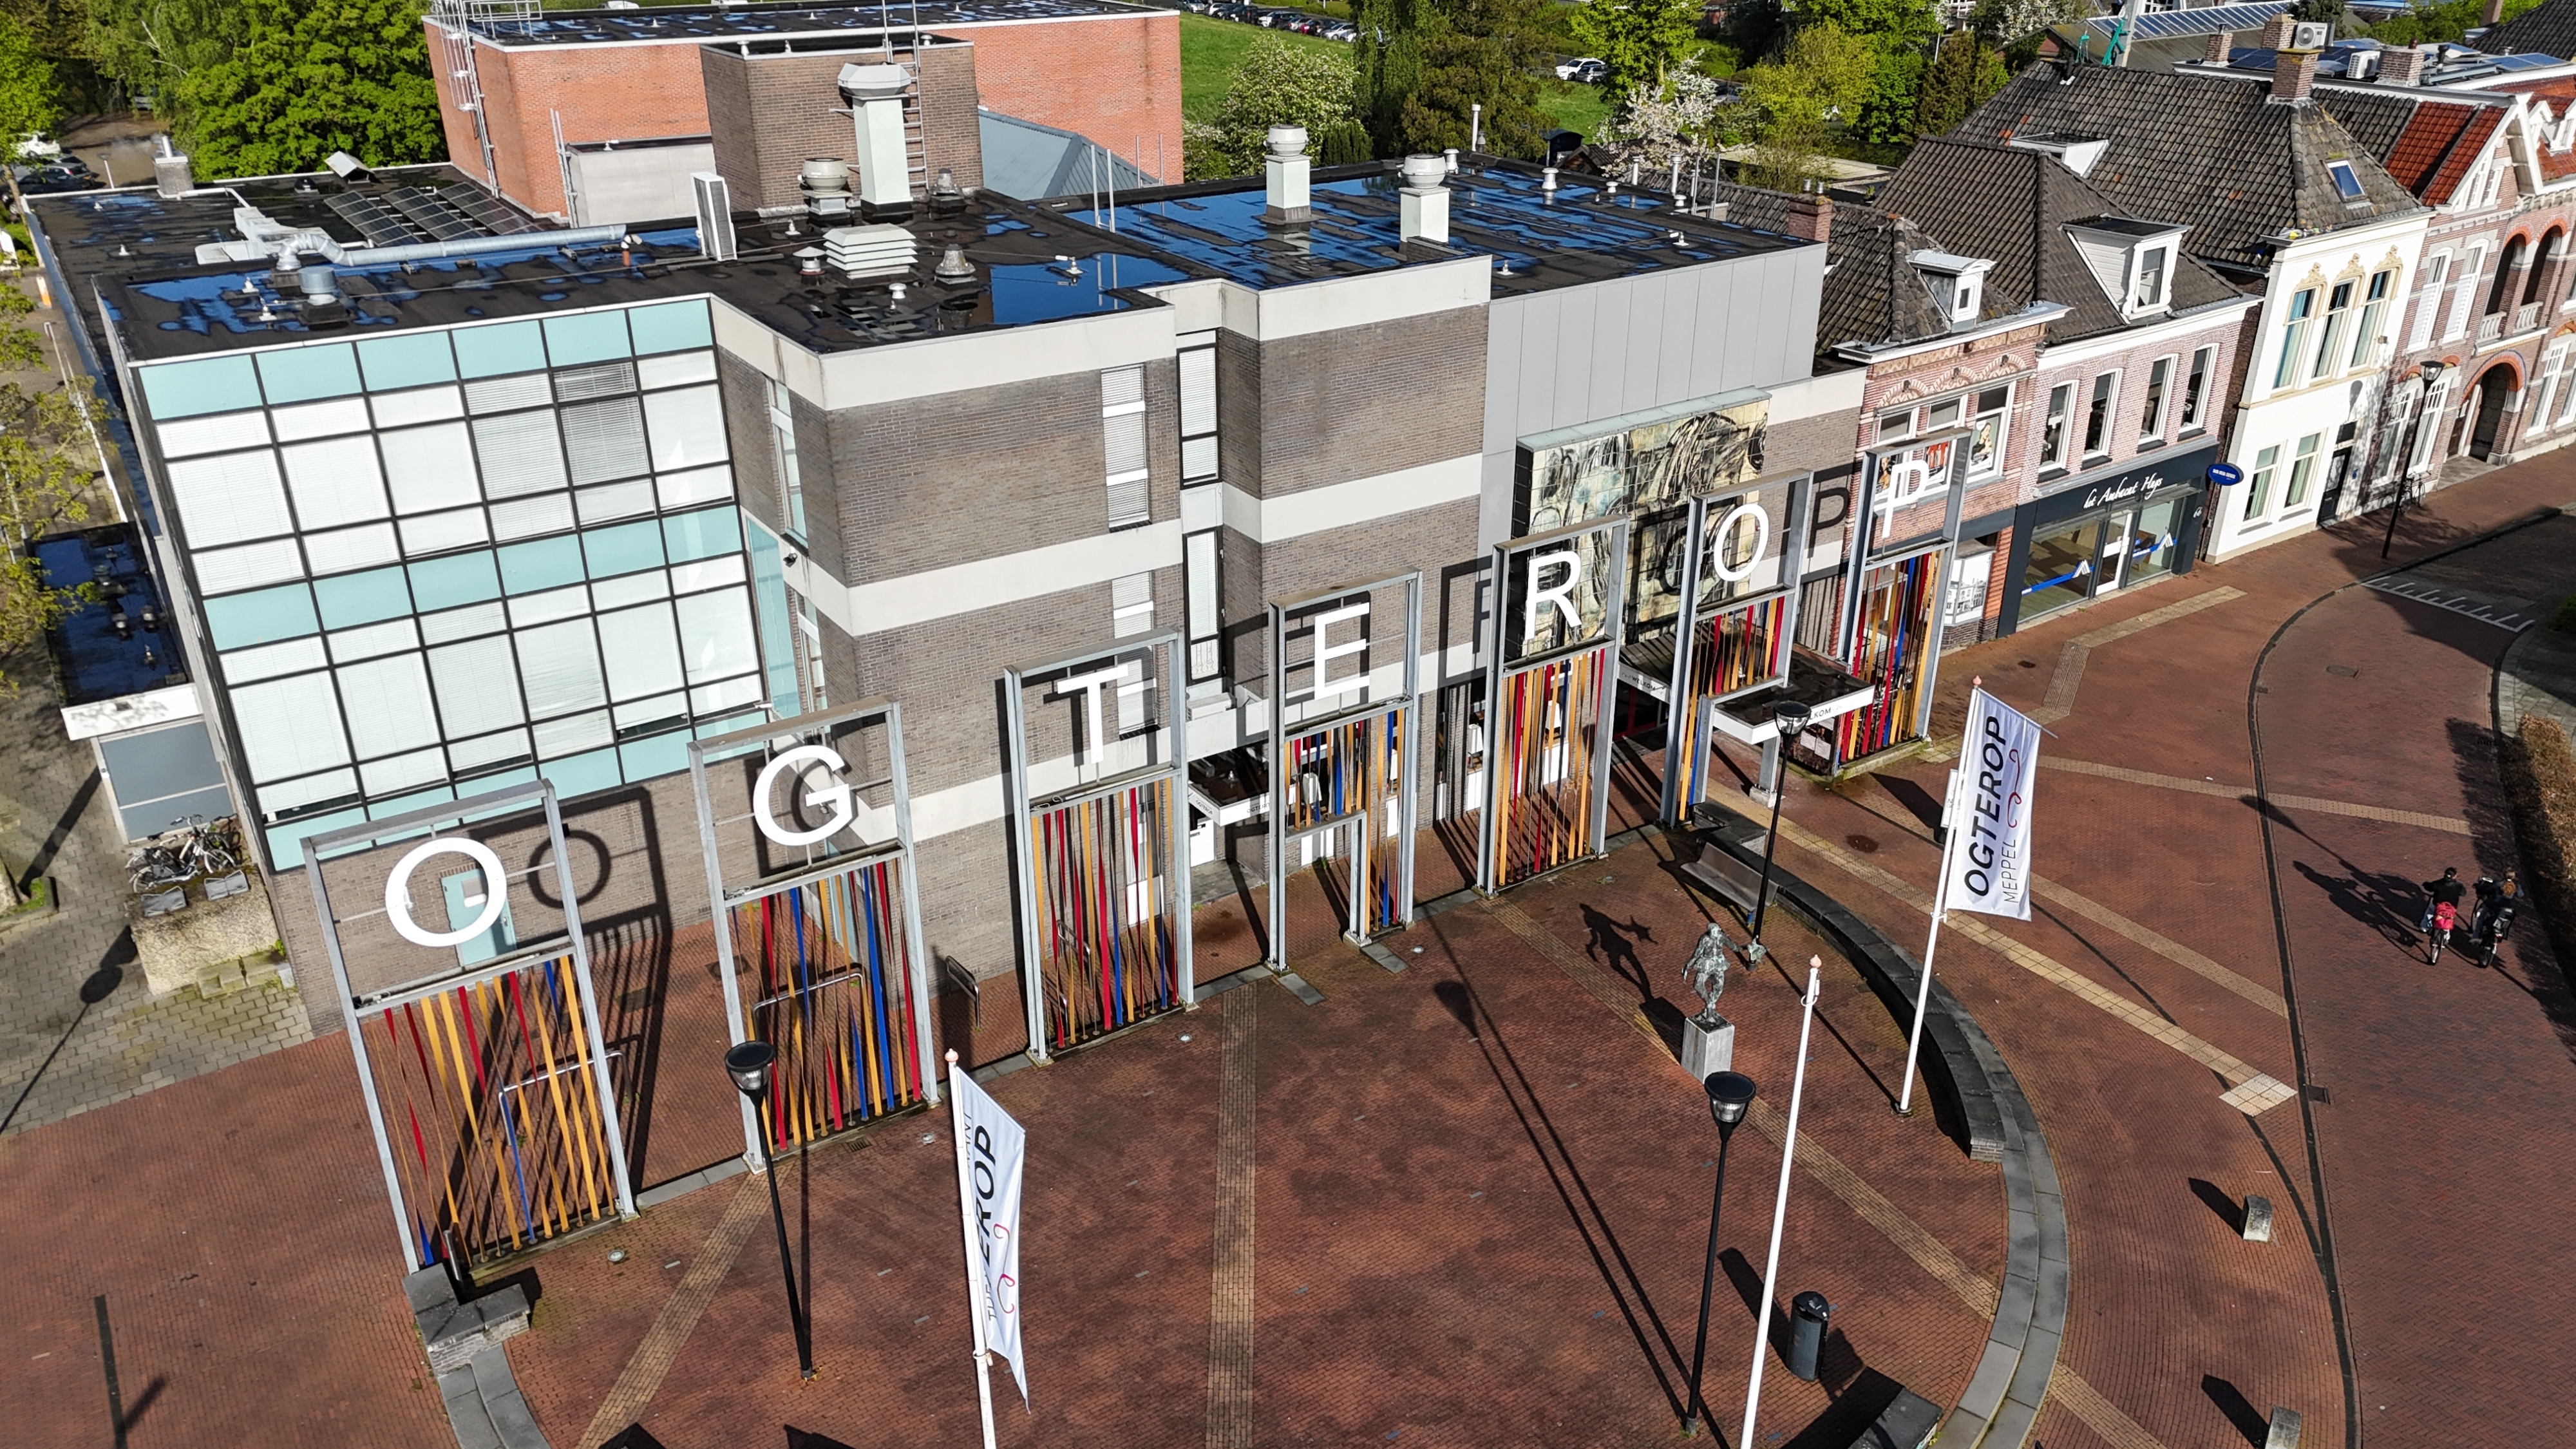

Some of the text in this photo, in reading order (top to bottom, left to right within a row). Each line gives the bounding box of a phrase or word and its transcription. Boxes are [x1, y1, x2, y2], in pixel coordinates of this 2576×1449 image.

[1632, 676, 1656, 691] WELKOM
[1810, 707, 1832, 720] LKOM
[1247, 802, 1271, 813] OGTERO
[1964, 715, 2006, 897] OGTEROP
[2001, 838, 2018, 903] MEPPEL
[974, 1125, 996, 1267] EROP
